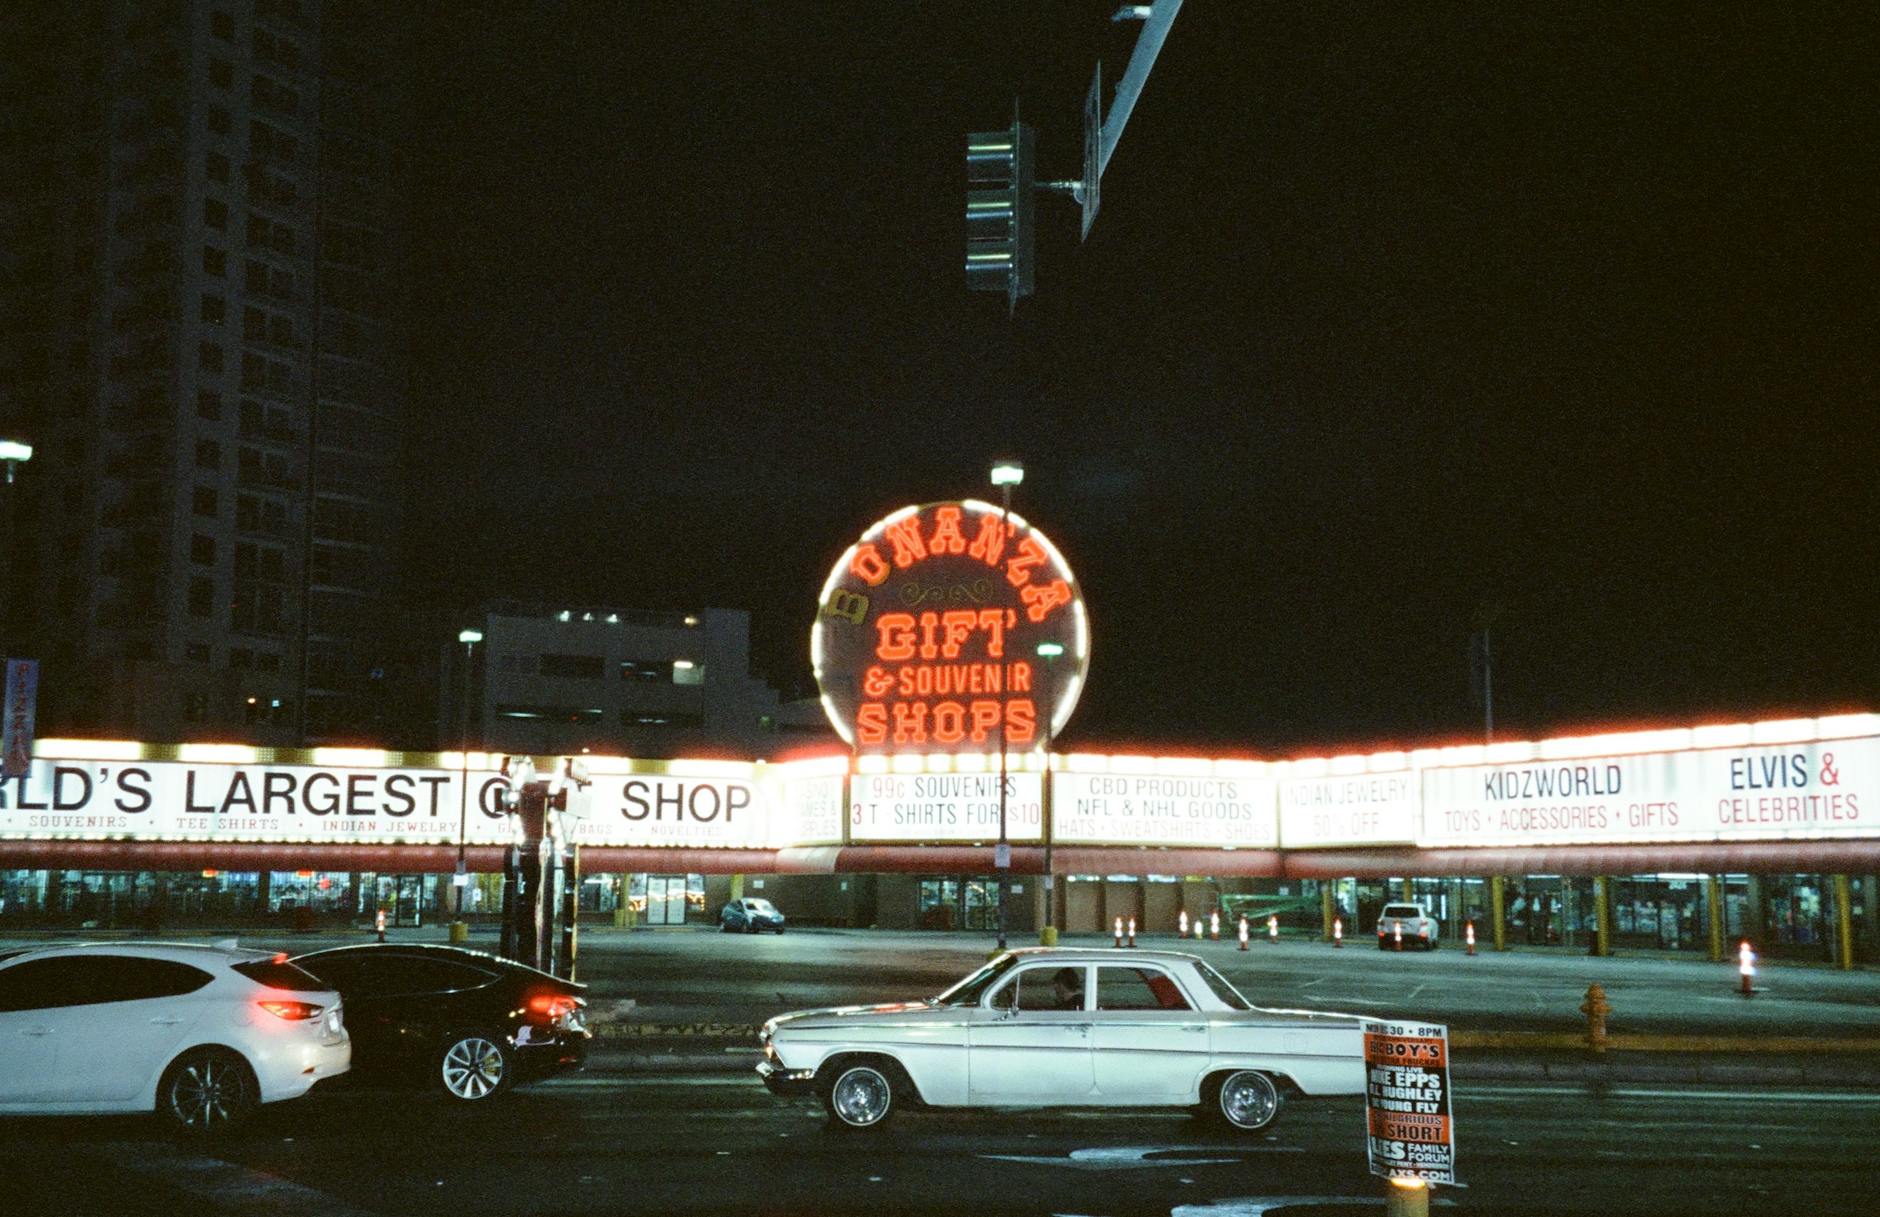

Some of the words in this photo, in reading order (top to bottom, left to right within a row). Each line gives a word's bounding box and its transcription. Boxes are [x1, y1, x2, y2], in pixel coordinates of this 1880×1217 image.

[826, 506, 1072, 624] BONANZA
[875, 608, 1017, 660] GIFT
[863, 664, 895, 697] &
[899, 661, 1032, 695] SOUVENIR
[856, 699, 1036, 744] SHOPS
[1484, 765, 1622, 800] KIDZWORLD
[1730, 753, 1808, 791] ELVIS
[1819, 752, 1840, 786] &
[185, 770, 451, 817] LARGEST
[621, 780, 752, 823] SHOP
[1089, 776, 1128, 796] CBD
[1135, 779, 1239, 799] PRODUCTS
[1338, 777, 1409, 805] JEWELRY
[852, 803, 863, 825] 3
[966, 803, 1000, 825] FOR
[1076, 798, 1113, 817] NFL
[1121, 800, 1135, 817] &
[1143, 800, 1181, 818] NHL
[1187, 801, 1253, 821] GOODS
[1445, 810, 1481, 832] TOYS
[1499, 805, 1608, 831] ACCESSORIES
[1628, 801, 1679, 827] GIFTS
[1718, 794, 1860, 825] CELEBRITIES
[29, 815, 128, 828] SOUVENIRS
[176, 817, 208, 830] TEE
[217, 818, 279, 831] SHIRTS
[322, 820, 377, 832] INDIAN
[385, 821, 458, 834] JEWELRY
[1058, 819, 1097, 837] HATS
[1111, 820, 1210, 839] SWEATSHIRTS
[1225, 822, 1272, 841] SHOES
[1351, 811, 1379, 836] OFF
[1418, 1027, 1442, 1038] 8PM
[1395, 1072, 1440, 1089] EPPS
[1416, 1101, 1440, 1114] FLY
[1407, 1143, 1449, 1154] FAMILY
[1408, 1152, 1450, 1163] FORUM
